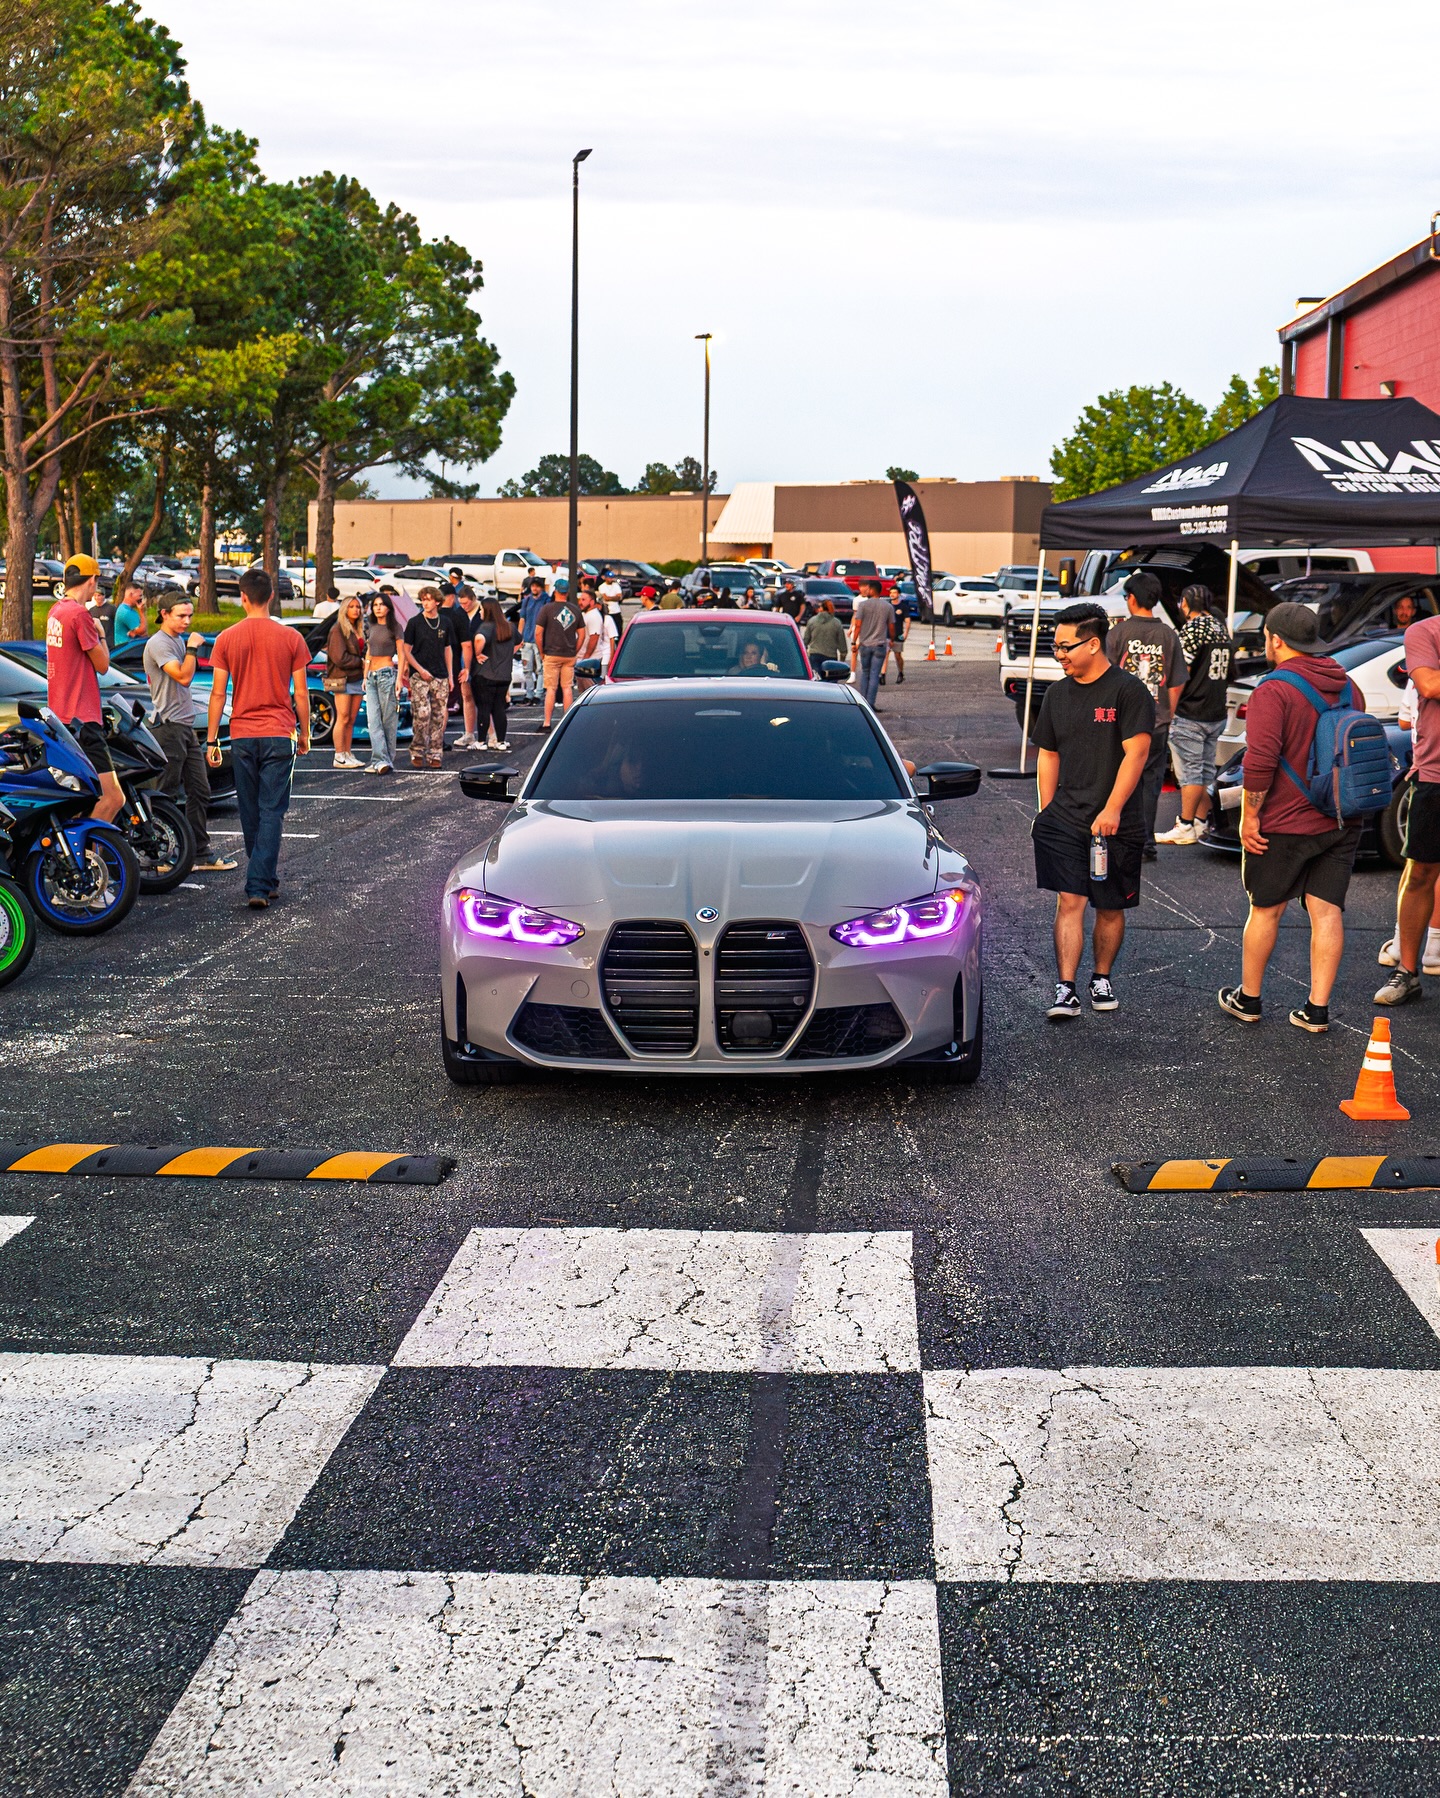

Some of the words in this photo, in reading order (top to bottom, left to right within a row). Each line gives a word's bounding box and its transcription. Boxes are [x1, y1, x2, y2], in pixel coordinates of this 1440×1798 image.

[1290, 437, 1440, 473] NW
[1343, 471, 1434, 483] NORTHWEST
[1331, 481, 1404, 493] CUSTOM
[1402, 483, 1440, 493] AUDI
[1127, 639, 1164, 656] Coors
[1093, 707, 1117, 723] 東京
